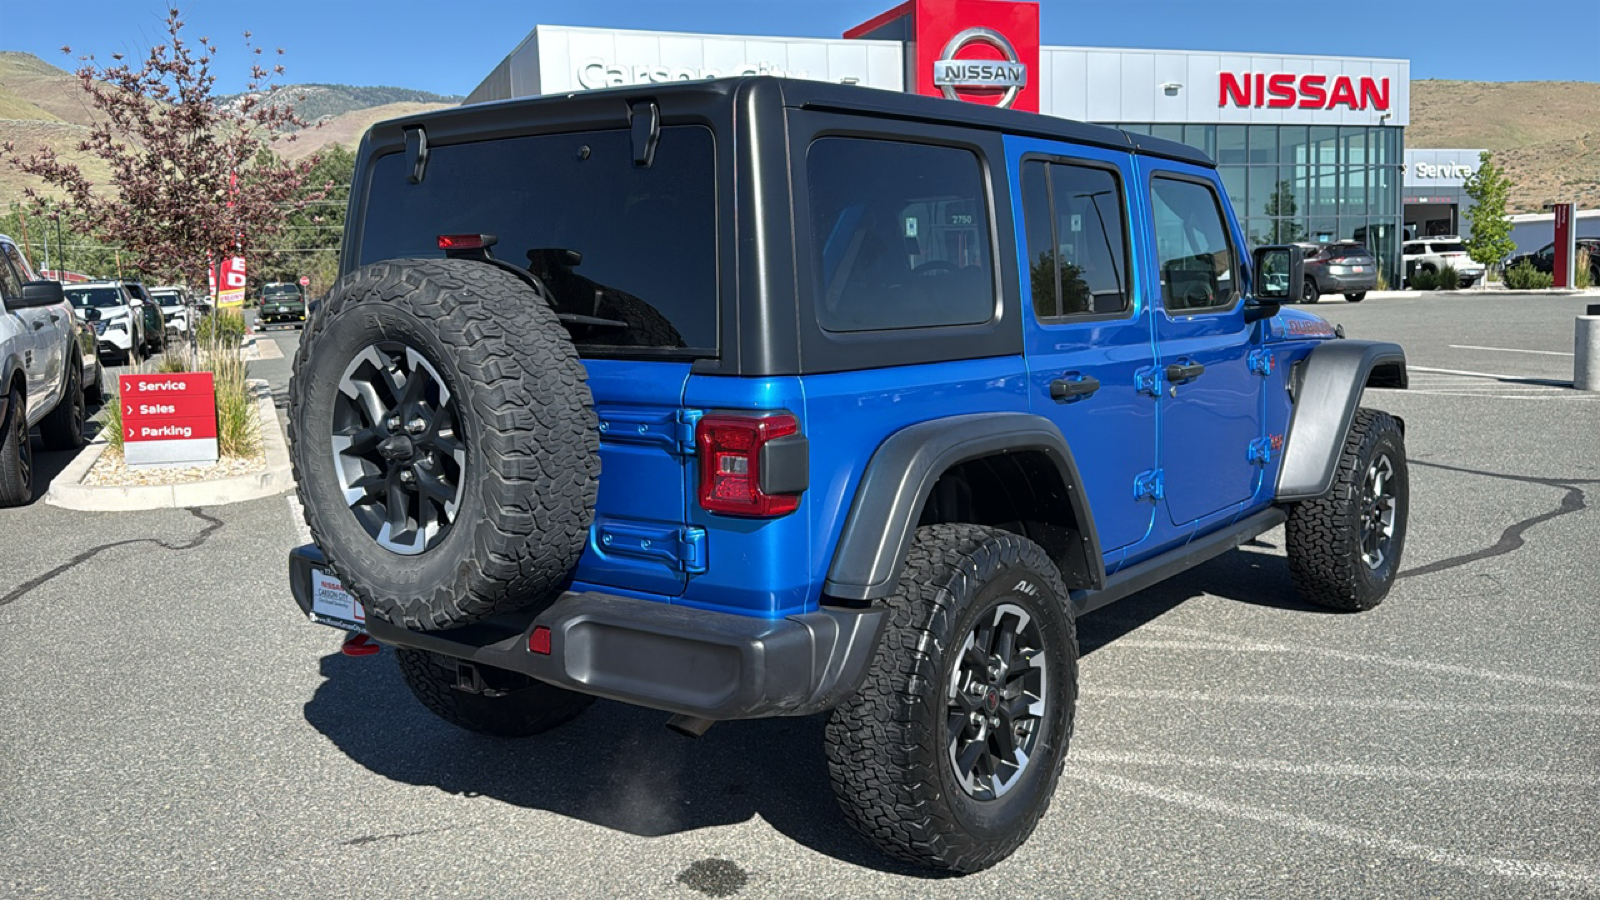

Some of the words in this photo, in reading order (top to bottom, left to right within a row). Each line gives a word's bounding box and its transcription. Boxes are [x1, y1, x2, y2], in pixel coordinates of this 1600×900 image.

[945, 65, 1020, 81] NISSAN
[1219, 72, 1389, 111] NISSAN
[1415, 160, 1473, 179] Service
[138, 380, 186, 391] Service
[139, 404, 176, 415] Sales
[141, 425, 192, 437] Parking
